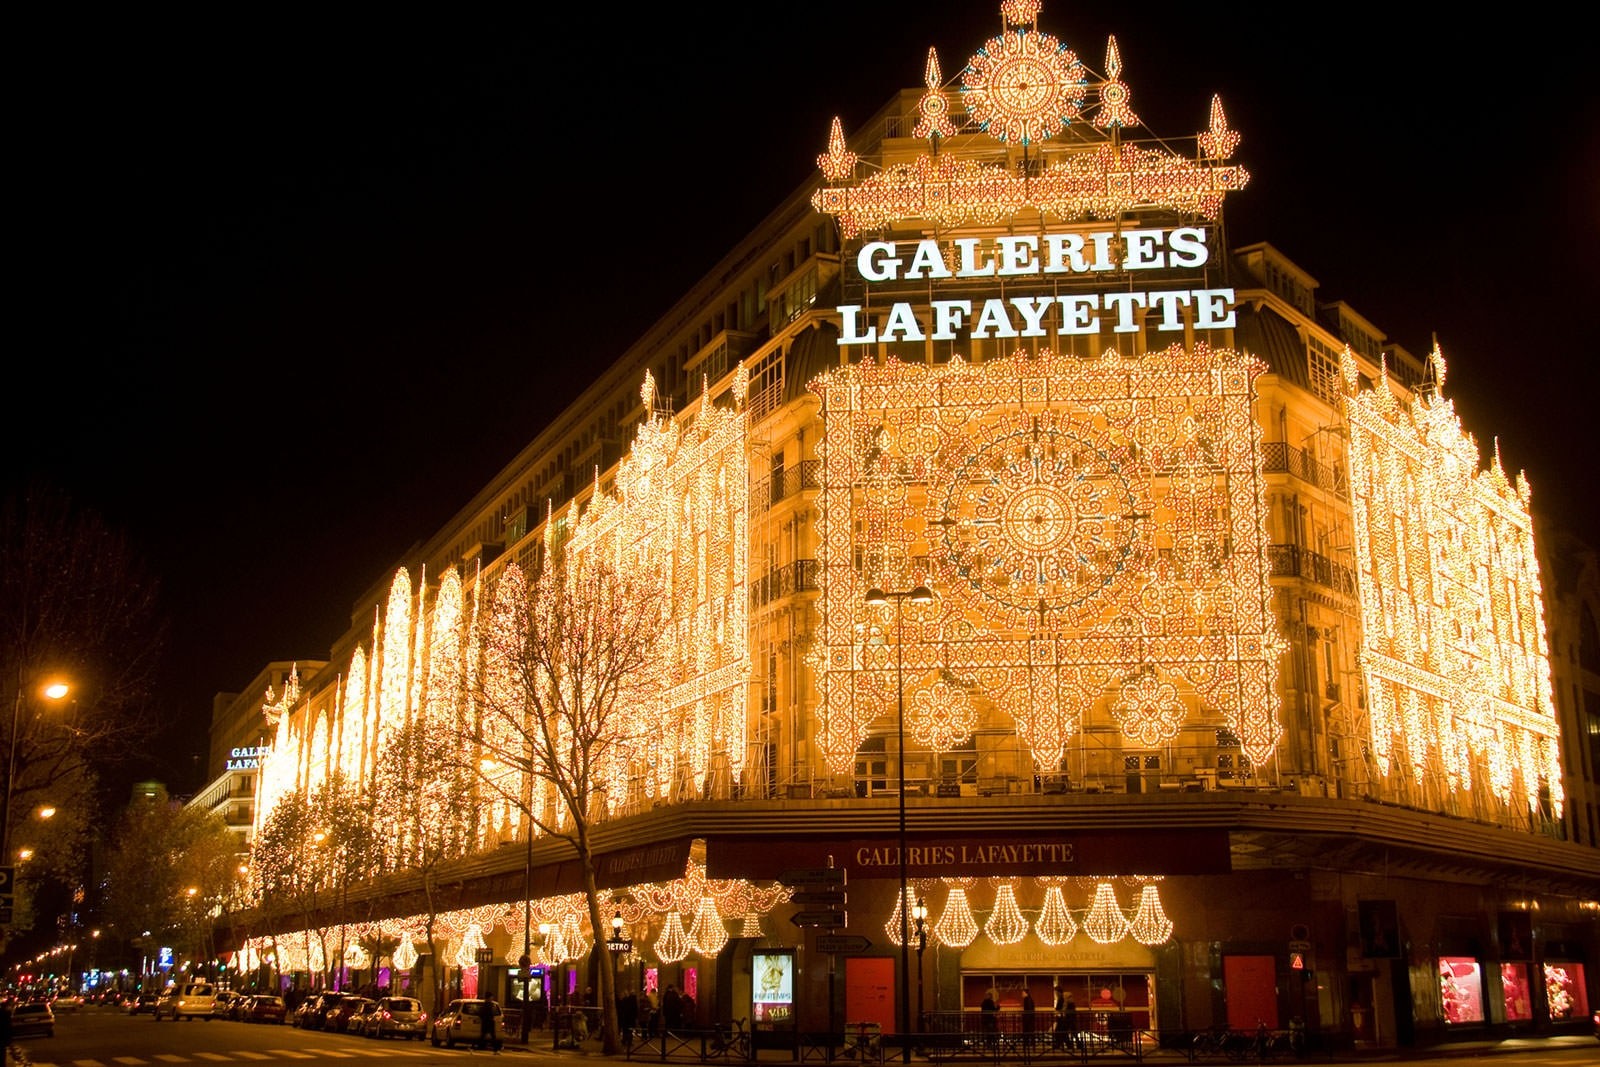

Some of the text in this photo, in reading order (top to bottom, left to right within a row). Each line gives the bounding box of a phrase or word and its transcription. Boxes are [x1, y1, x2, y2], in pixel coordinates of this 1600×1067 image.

[857, 227, 1209, 281] GALERIES
[836, 288, 1237, 345] LAFAYETTE
[960, 843, 1074, 864] LAFAYETTE
